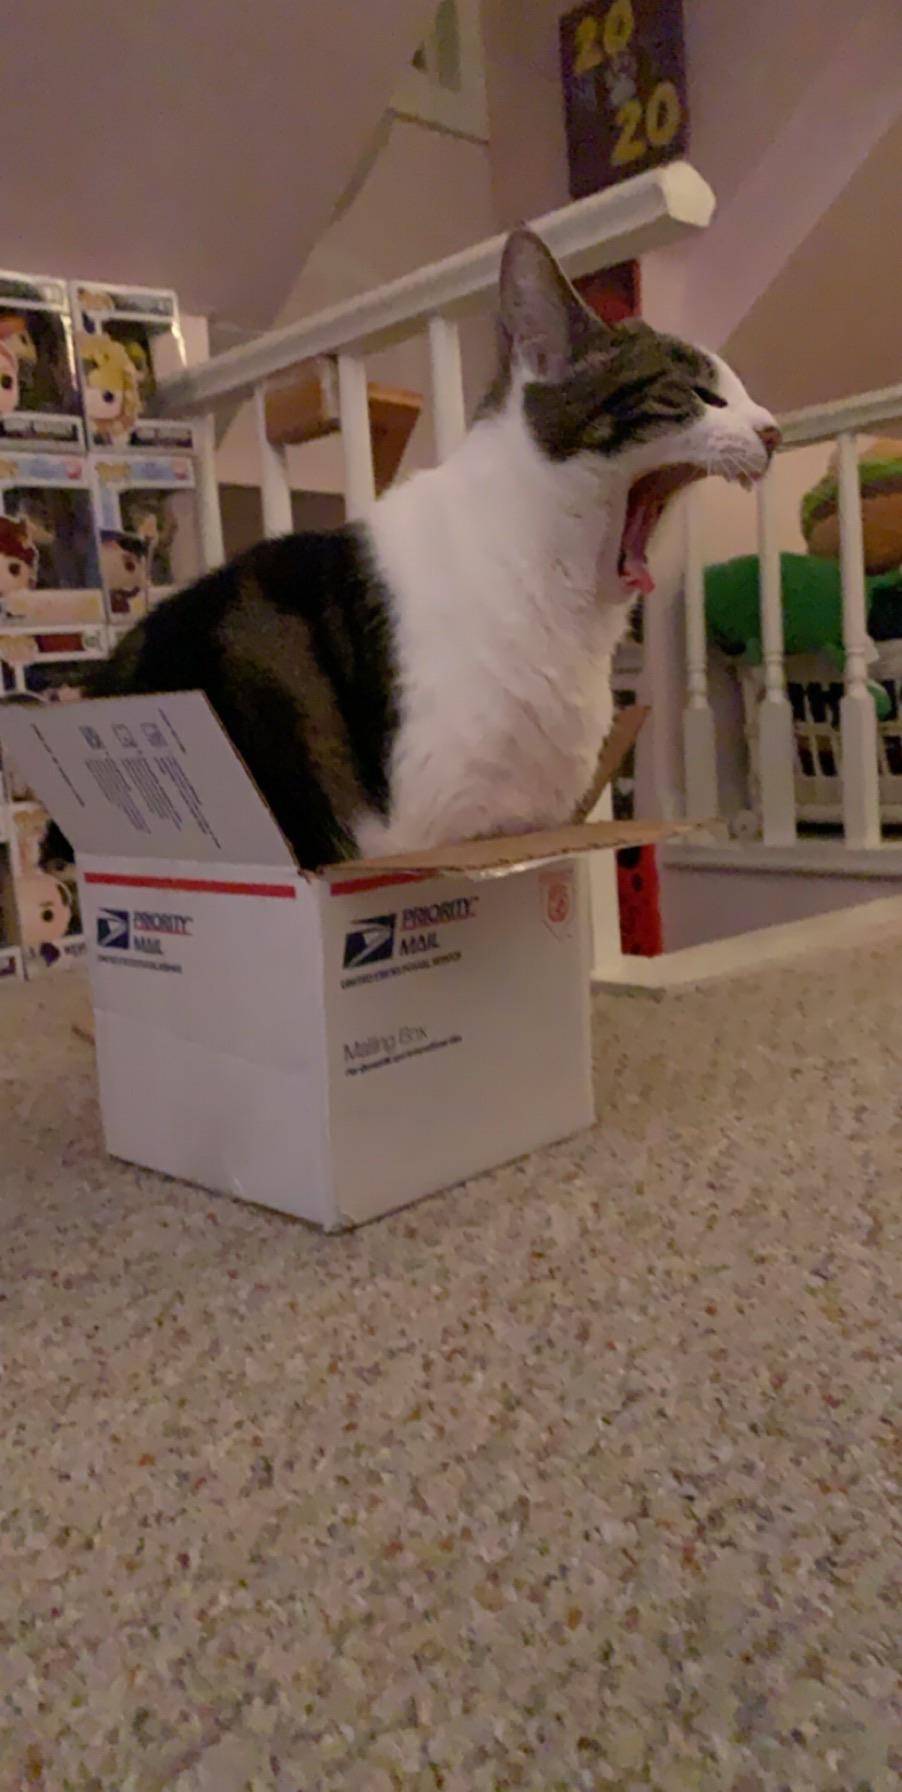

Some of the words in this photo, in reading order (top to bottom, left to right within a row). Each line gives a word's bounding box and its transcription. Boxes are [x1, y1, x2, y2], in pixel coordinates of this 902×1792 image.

[574, 0, 634, 76] 20
[609, 80, 681, 166] 20
[133, 911, 193, 936] PRIORITY
[401, 897, 474, 931] PRIORITY
[400, 932, 439, 956] MAIL
